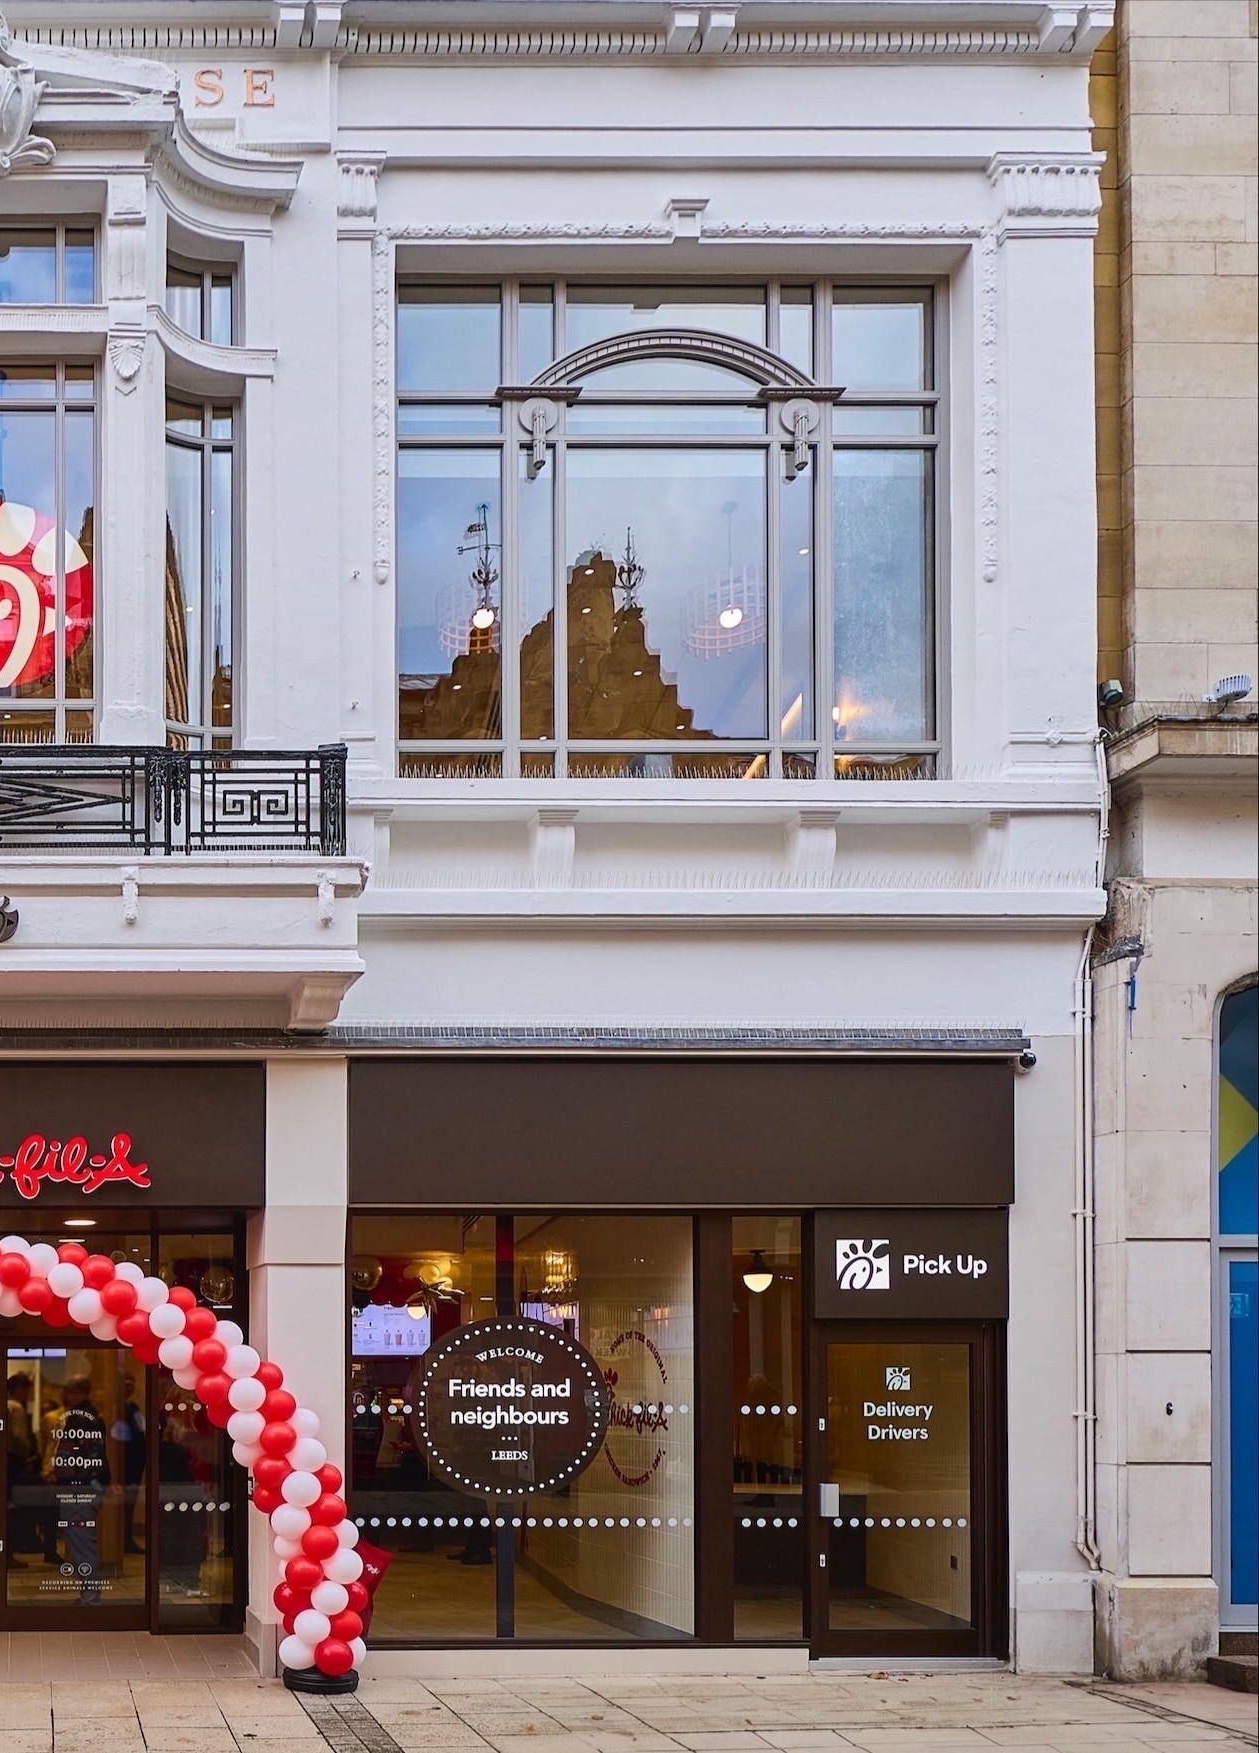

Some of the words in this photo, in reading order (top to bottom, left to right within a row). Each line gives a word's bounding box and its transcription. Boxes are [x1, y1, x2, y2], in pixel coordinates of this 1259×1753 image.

[903, 1254, 952, 1275] Pick
[956, 1254, 988, 1279] Up
[475, 1346, 545, 1364] WELCOME
[448, 1377, 526, 1398] Friends
[530, 1377, 571, 1398] and
[450, 1405, 570, 1430] neighbours
[863, 1401, 934, 1420] Delivery
[51, 1429, 102, 1439] 10:00am
[867, 1424, 929, 1440] Drivers
[51, 1456, 103, 1469] 10:00pm
[491, 1450, 529, 1460] LEEDS
